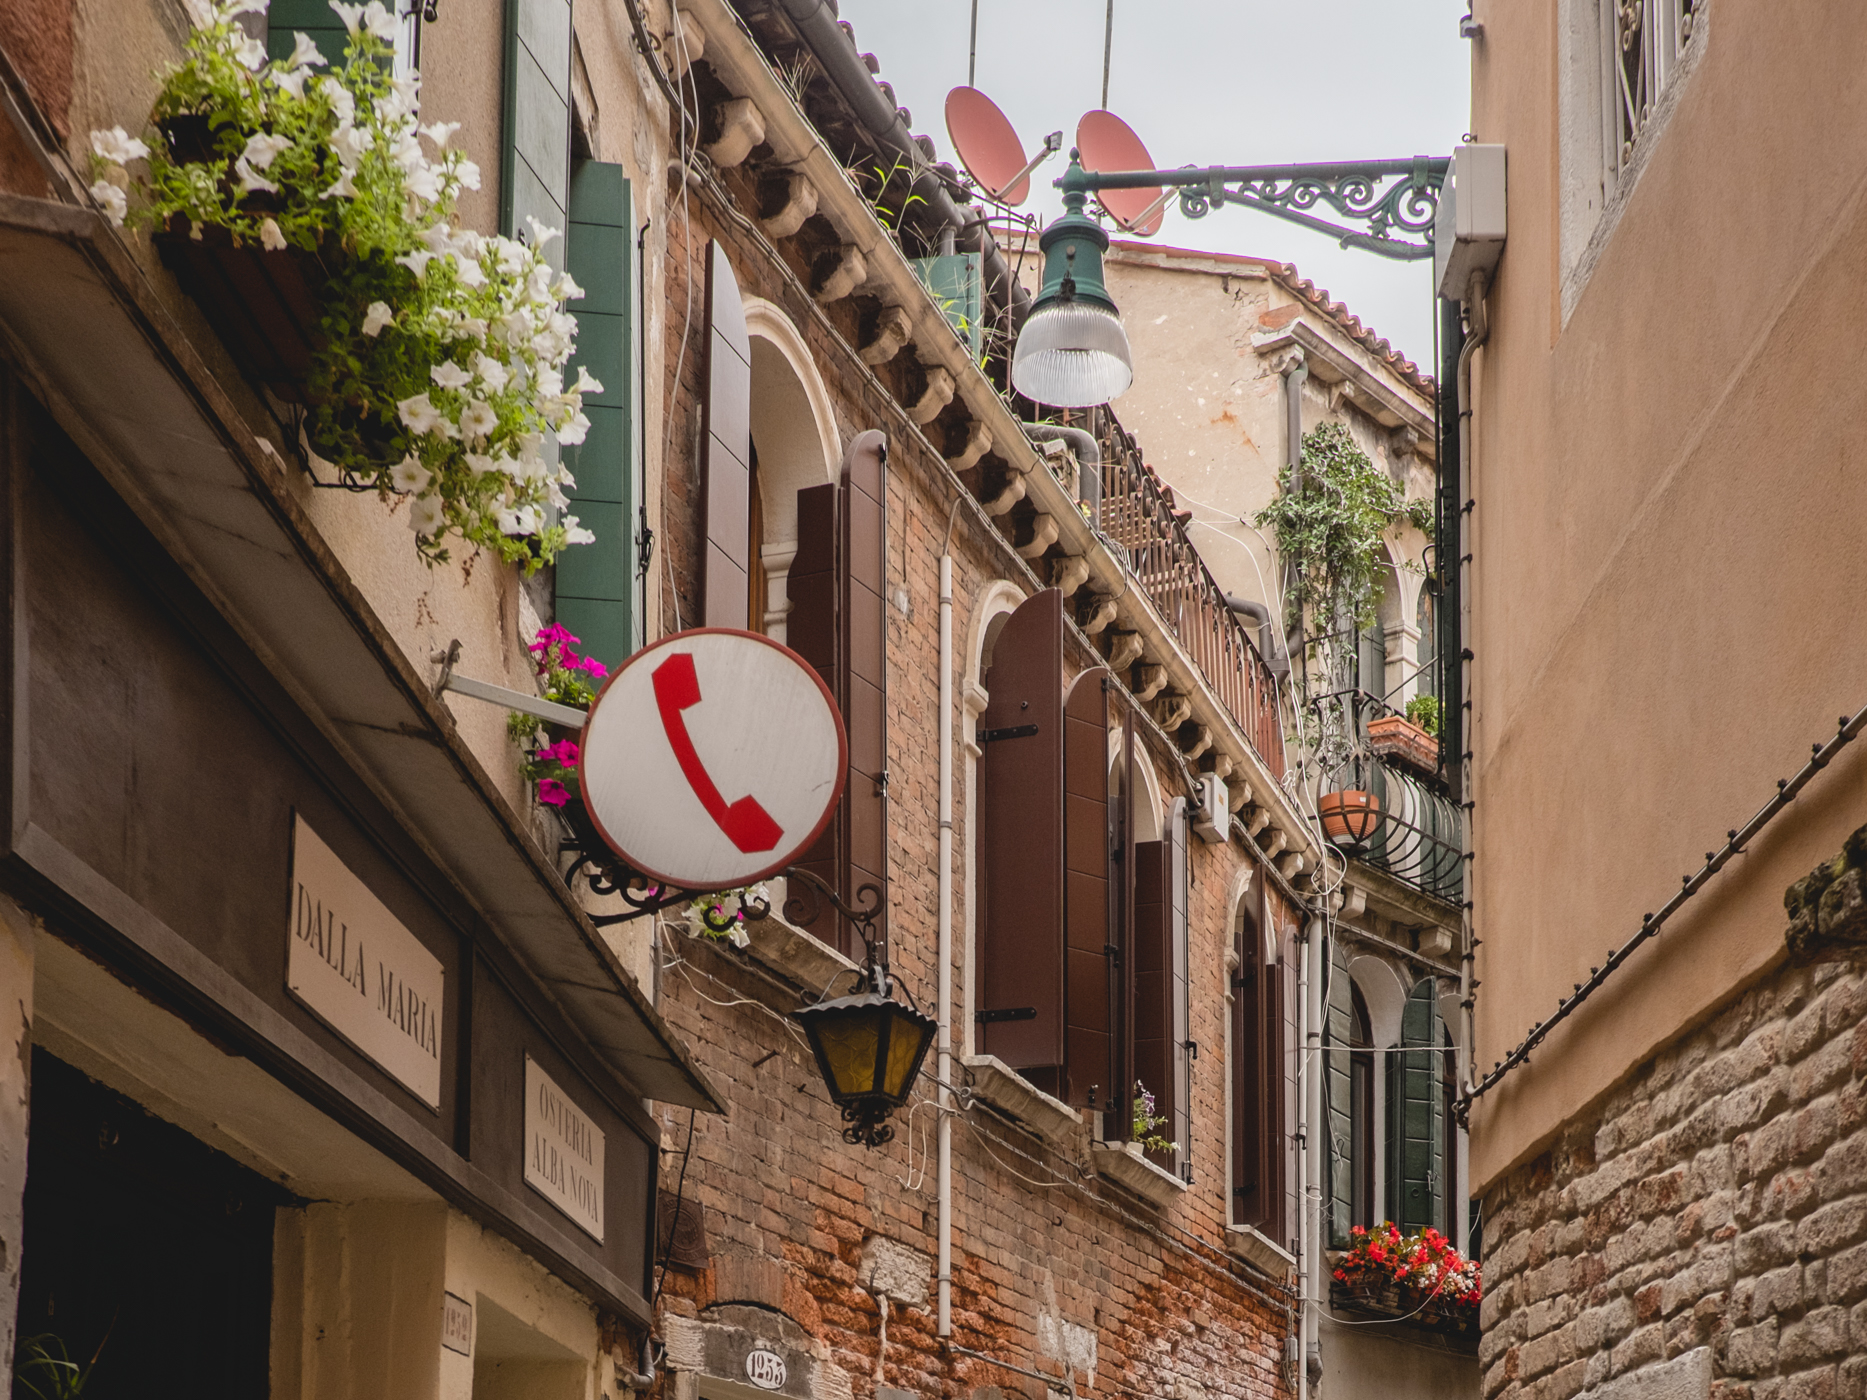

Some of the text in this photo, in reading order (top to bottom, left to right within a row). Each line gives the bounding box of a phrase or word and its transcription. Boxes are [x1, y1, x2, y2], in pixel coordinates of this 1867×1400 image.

[296, 881, 438, 1061] DALLA MARIA
[539, 1082, 594, 1167] OSTERIA
[532, 1131, 600, 1224] ALBA NOVA
